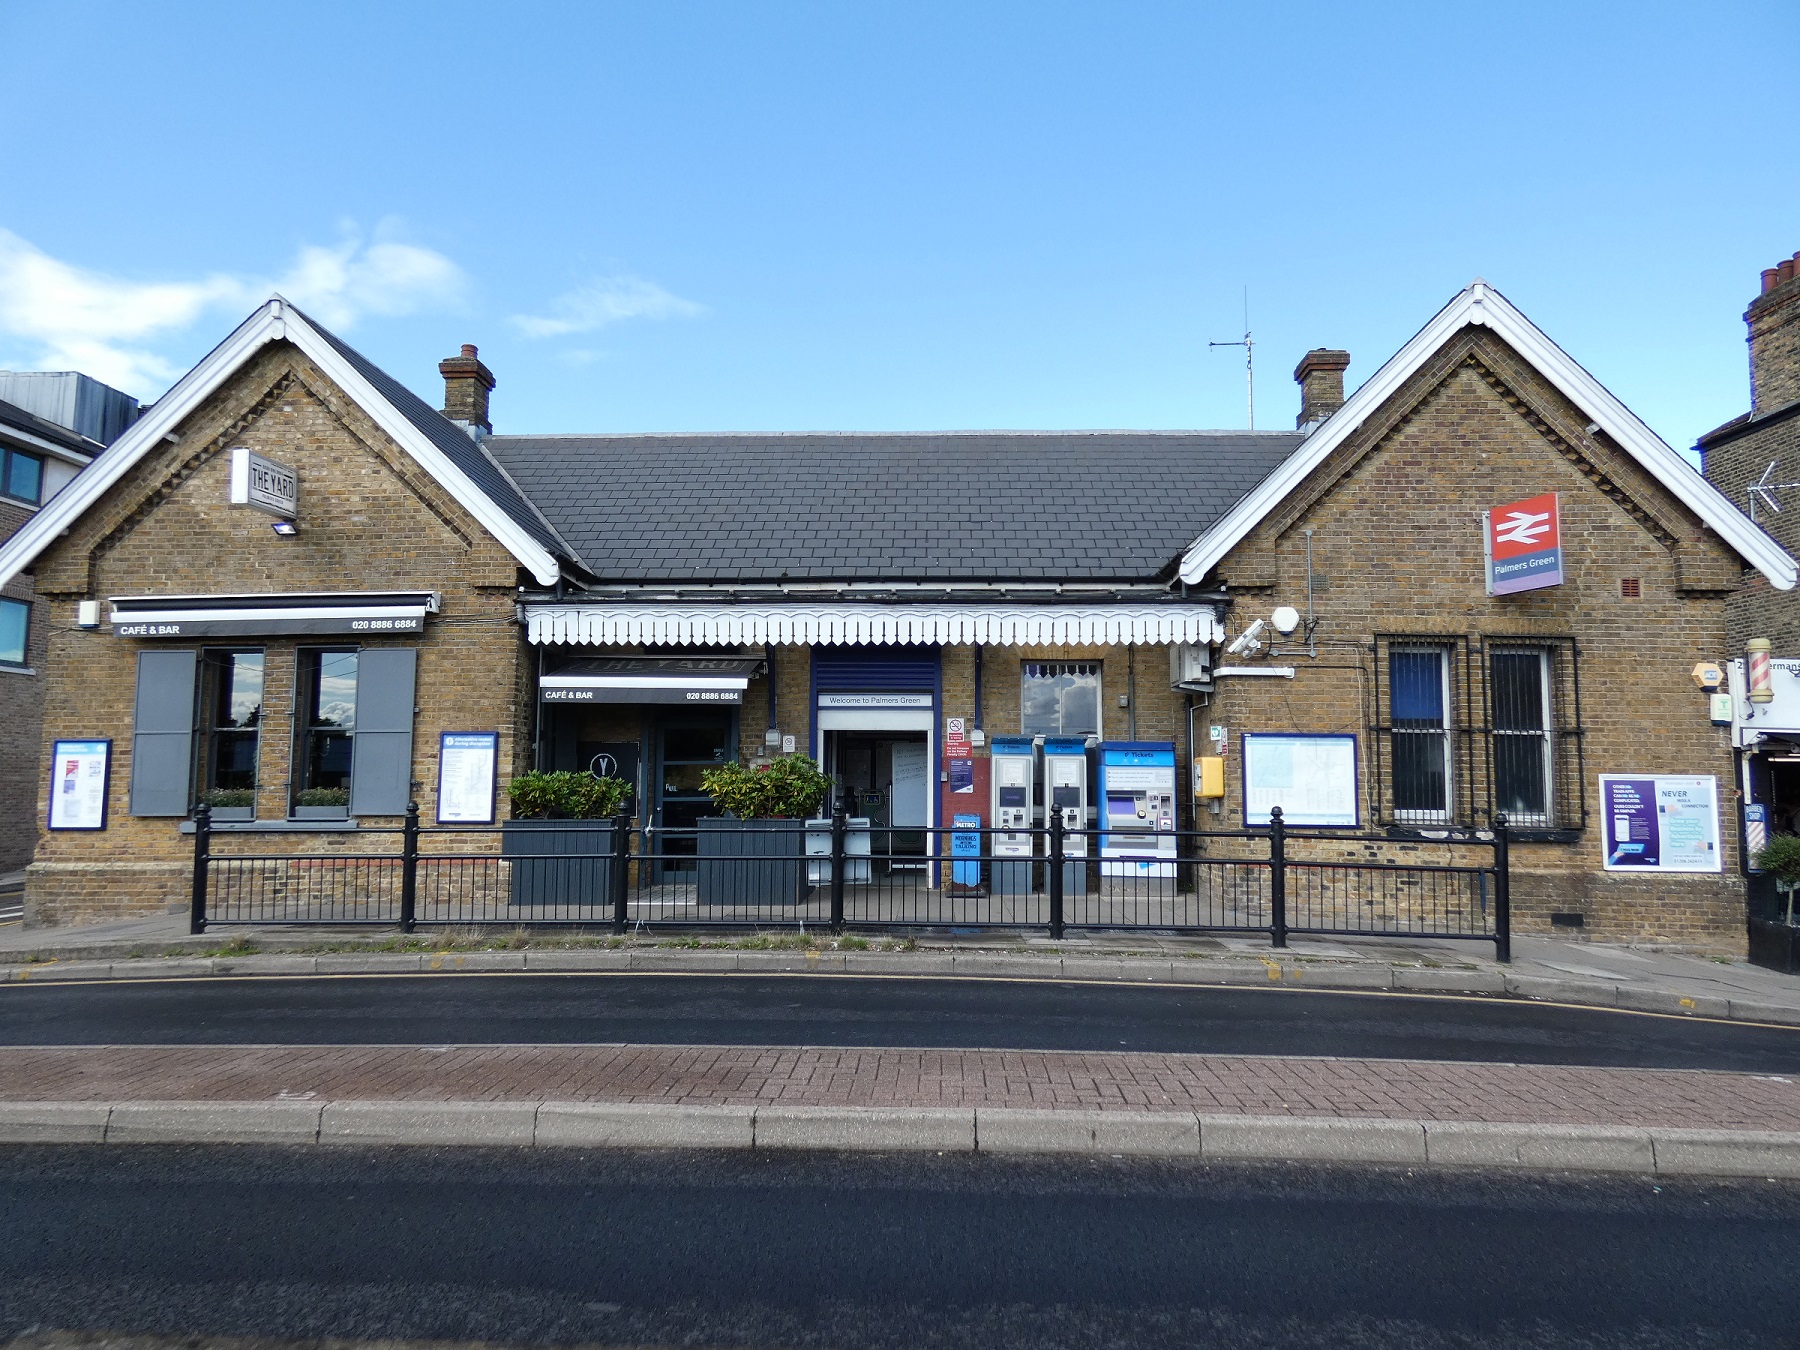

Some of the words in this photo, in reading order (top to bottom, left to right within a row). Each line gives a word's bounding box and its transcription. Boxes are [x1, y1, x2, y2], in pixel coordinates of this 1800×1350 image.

[252, 467, 269, 491] THE
[271, 474, 294, 499] YARD
[1495, 562, 1528, 575] Palmers
[1529, 556, 1555, 568] Green
[120, 624, 147, 635] CAFÉ
[149, 626, 157, 635] &
[158, 625, 180, 635] BAR
[352, 620, 369, 630] 020
[370, 620, 393, 630] 8886
[394, 619, 417, 629] 6884
[545, 690, 567, 699] CAFÉ
[568, 691, 574, 699] &
[575, 691, 593, 699] BAR
[686, 692, 700, 700] 020
[701, 692, 719, 700] 8886
[720, 692, 739, 700] 6884
